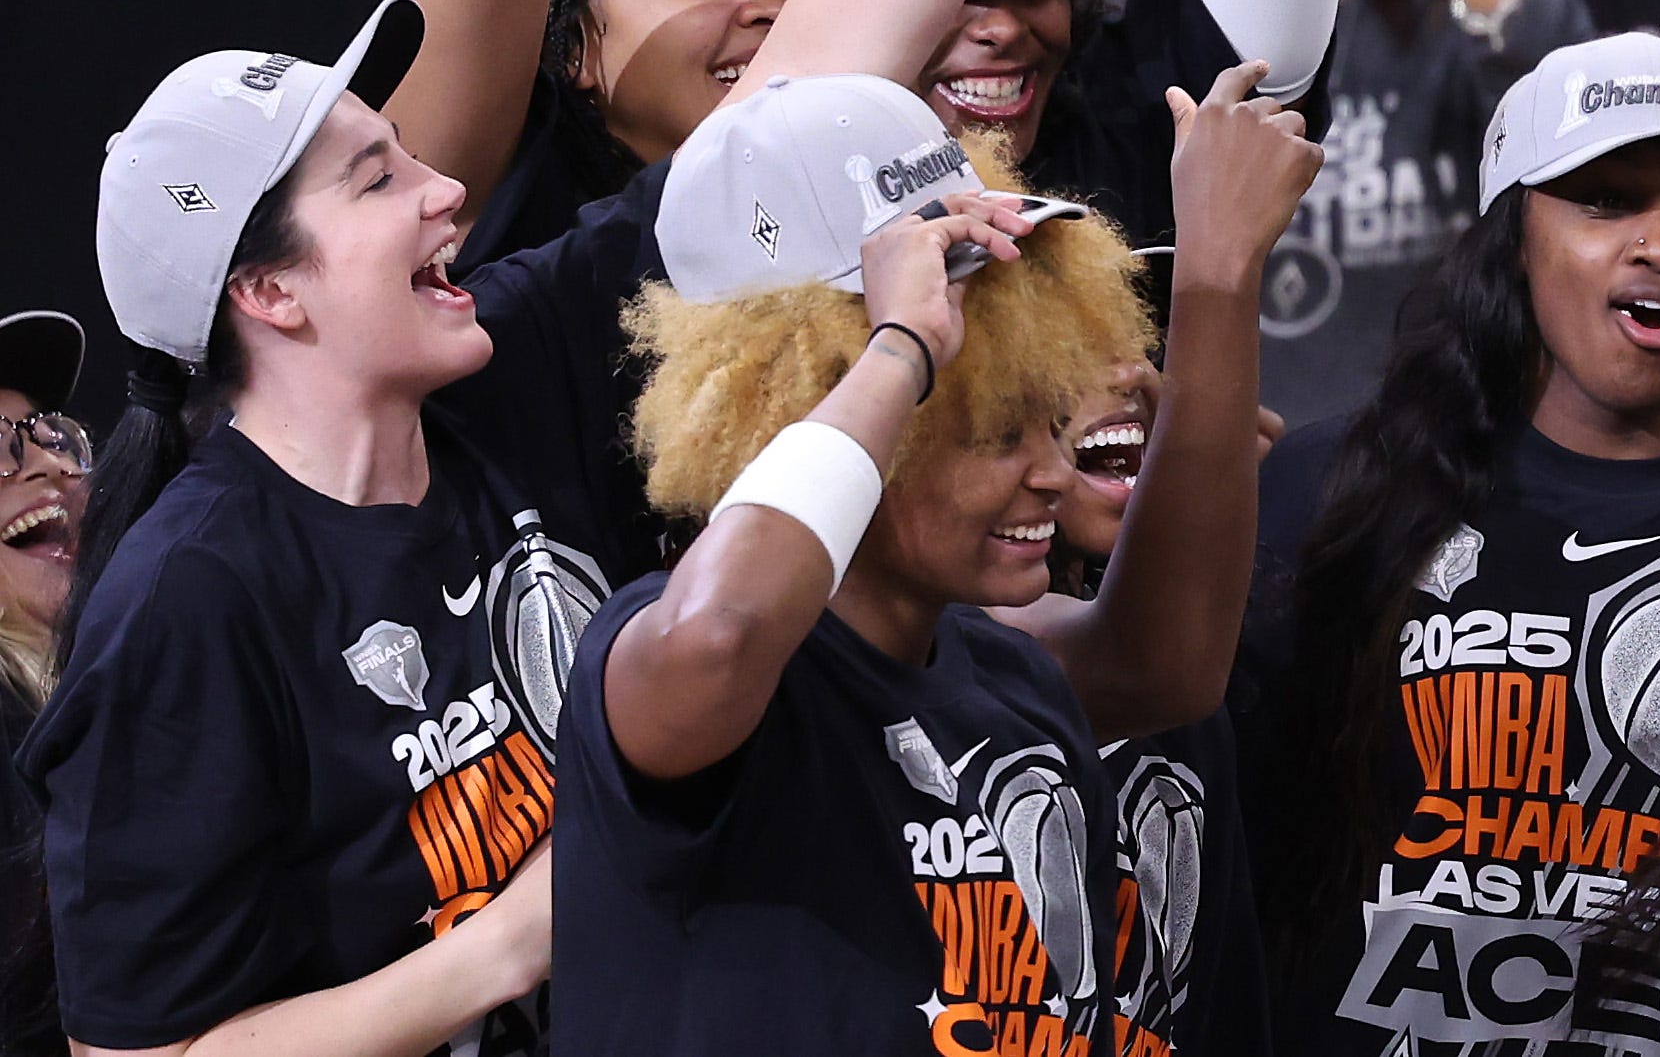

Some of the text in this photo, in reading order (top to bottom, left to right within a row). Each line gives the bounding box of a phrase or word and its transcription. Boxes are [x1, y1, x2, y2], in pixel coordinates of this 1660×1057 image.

[357, 635, 416, 675] FINALS
[1400, 609, 1572, 678] 2025
[391, 681, 511, 793] 2025
[1401, 671, 1567, 795] WNBA
[903, 811, 1004, 878] 202
[1378, 860, 1522, 914] LAS
